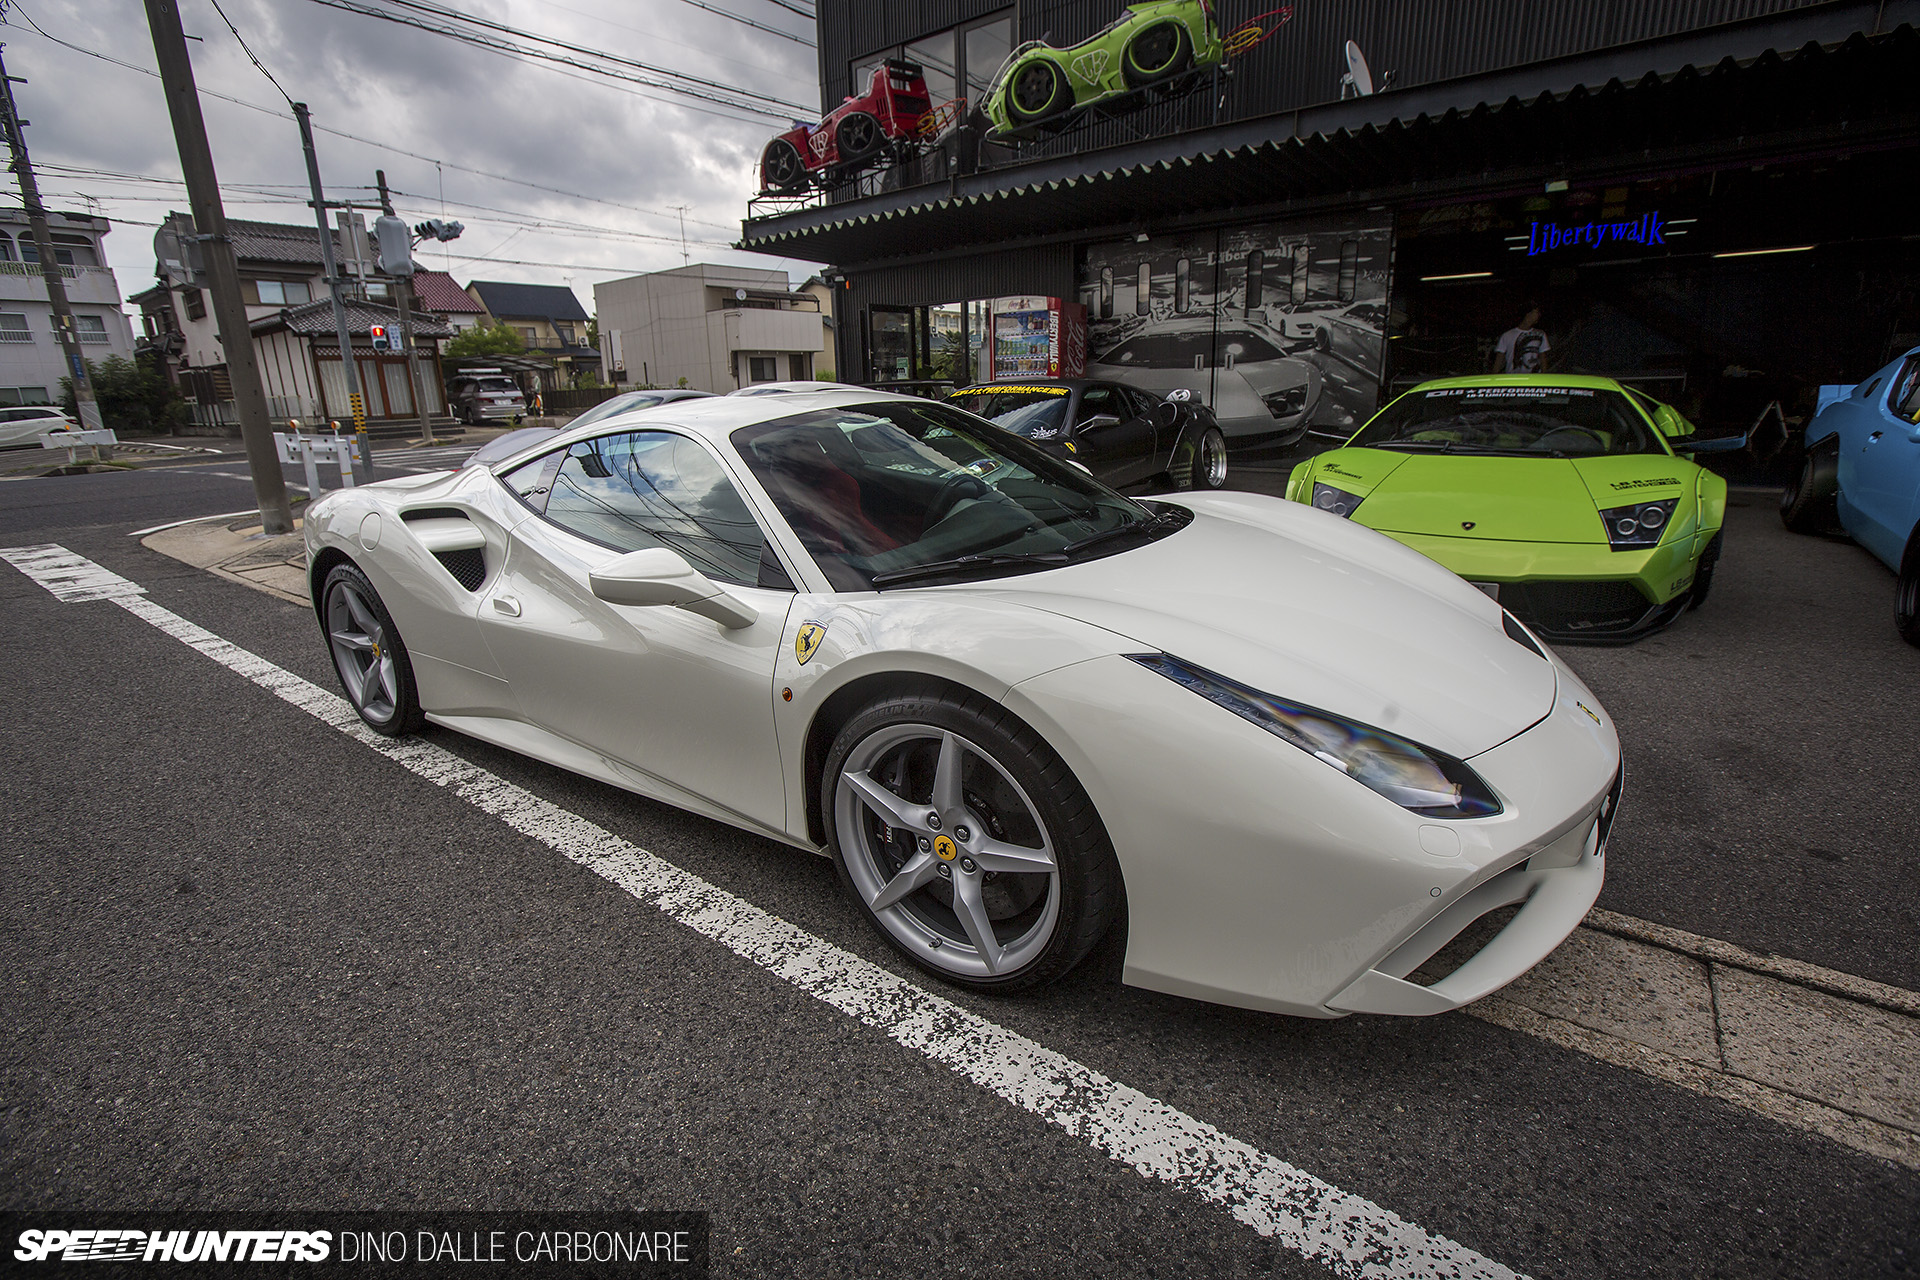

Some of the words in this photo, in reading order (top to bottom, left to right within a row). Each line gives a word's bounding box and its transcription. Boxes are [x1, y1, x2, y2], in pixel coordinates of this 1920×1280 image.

[1049, 310, 1059, 364] LIBERTYWALK
[1067, 315, 1085, 375] Cola
[1477, 387, 1568, 395] PERFORMANCE
